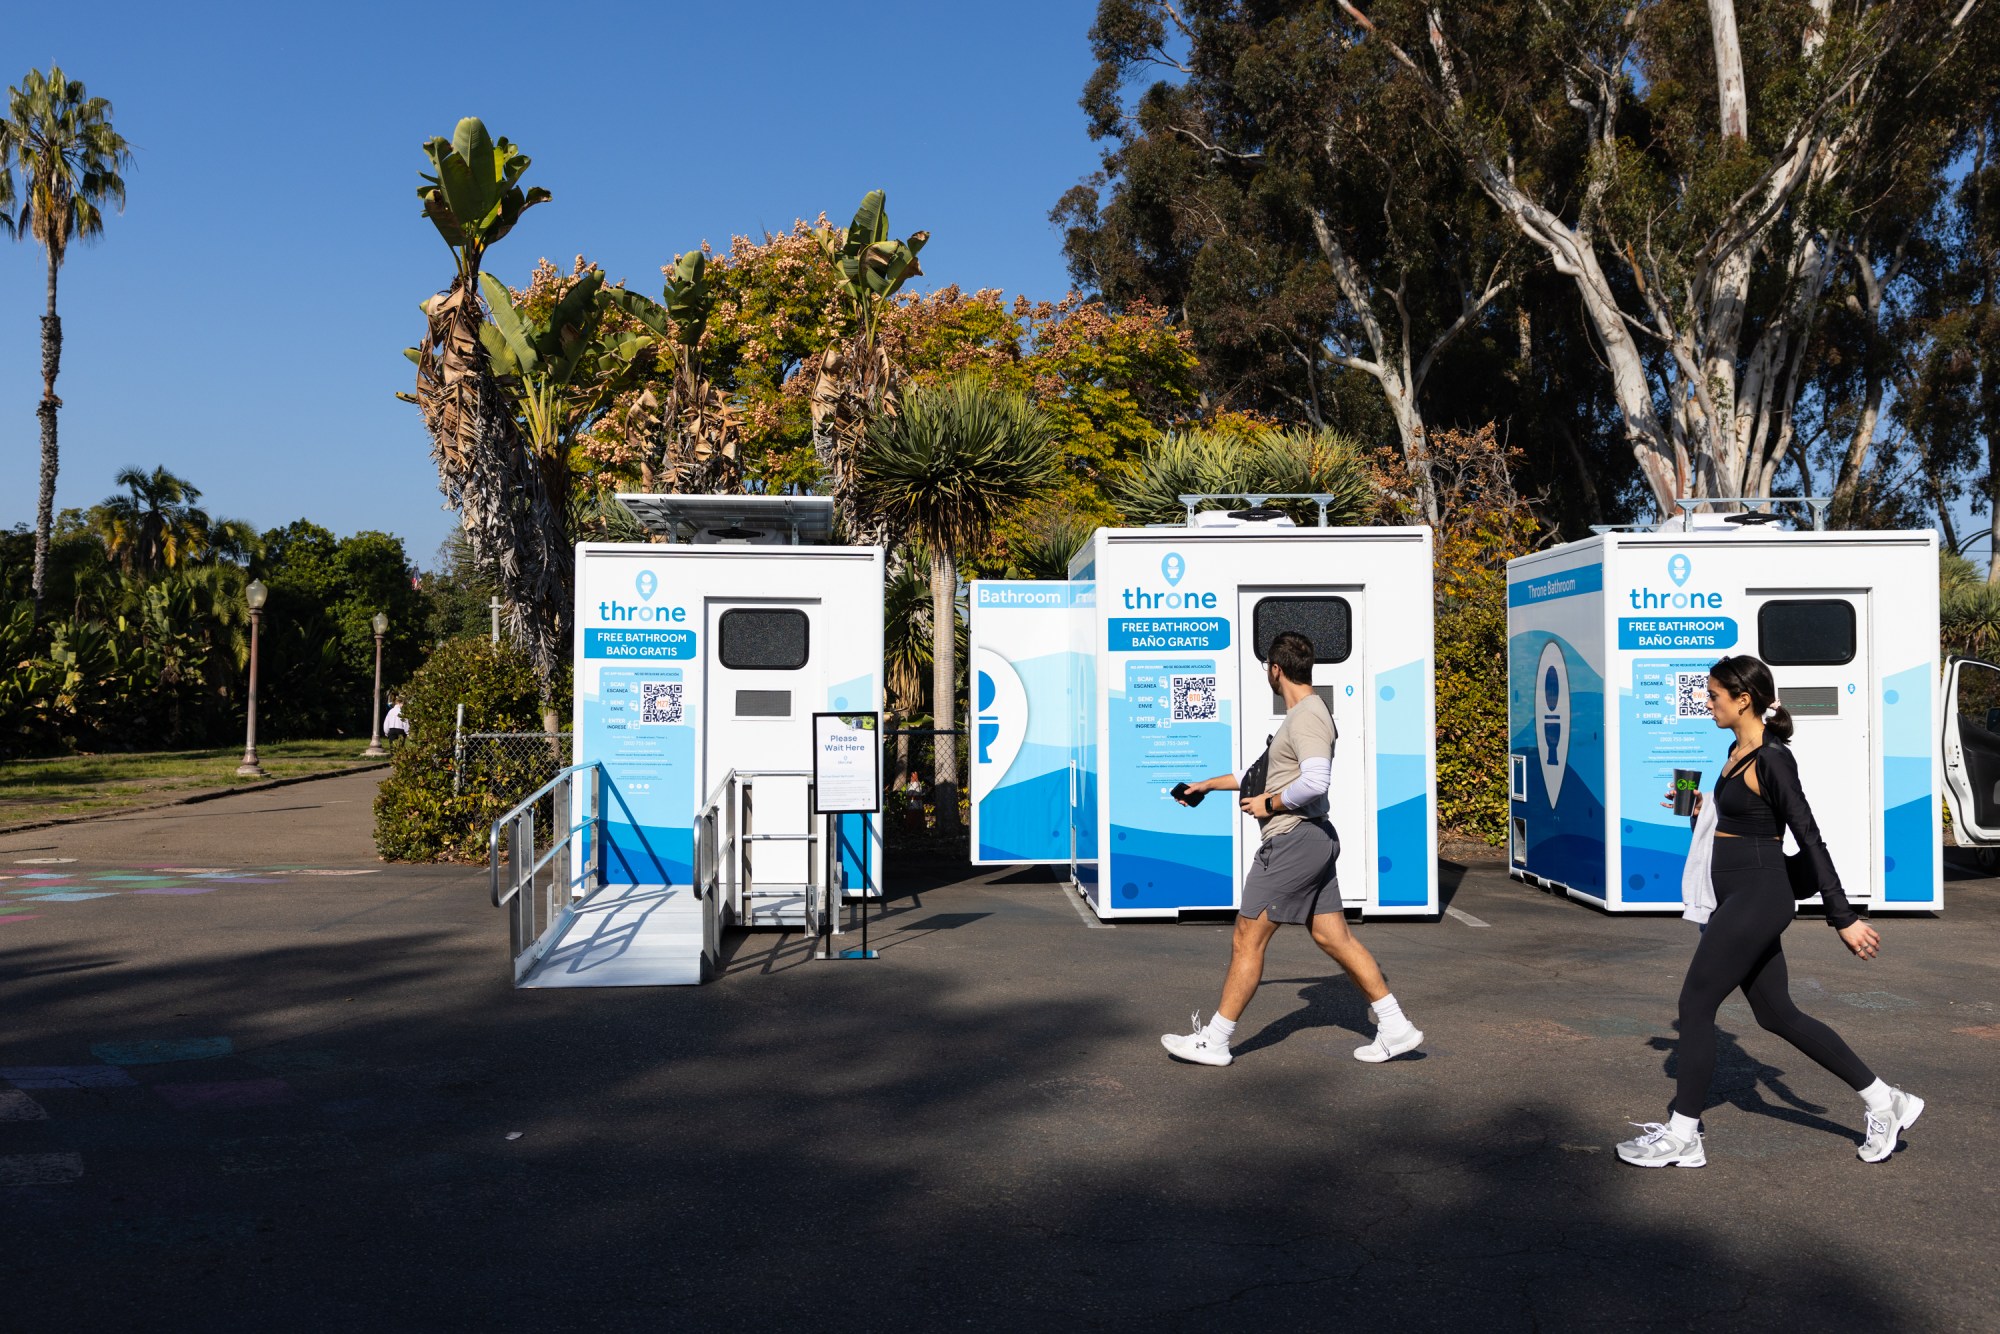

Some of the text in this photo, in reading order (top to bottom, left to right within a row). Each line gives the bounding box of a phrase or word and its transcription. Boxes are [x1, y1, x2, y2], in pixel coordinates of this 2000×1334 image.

[1527, 578, 1576, 599] Throne Bathroom
[980, 589, 1061, 604] Bathroom
[1122, 587, 1217, 609] throne
[1630, 587, 1723, 609] throne
[599, 600, 686, 622] throne
[1122, 622, 1219, 632] FREE BATHROOM
[1629, 622, 1725, 632] FREE BATHROOM
[597, 633, 687, 643] FREE BATHROOM
[1132, 636, 1209, 647] BAÑO GRATIS
[1638, 635, 1715, 646] BAÑO GRATIS
[606, 644, 678, 656] BAÑO GRATIS
[846, 744, 865, 752] Here
